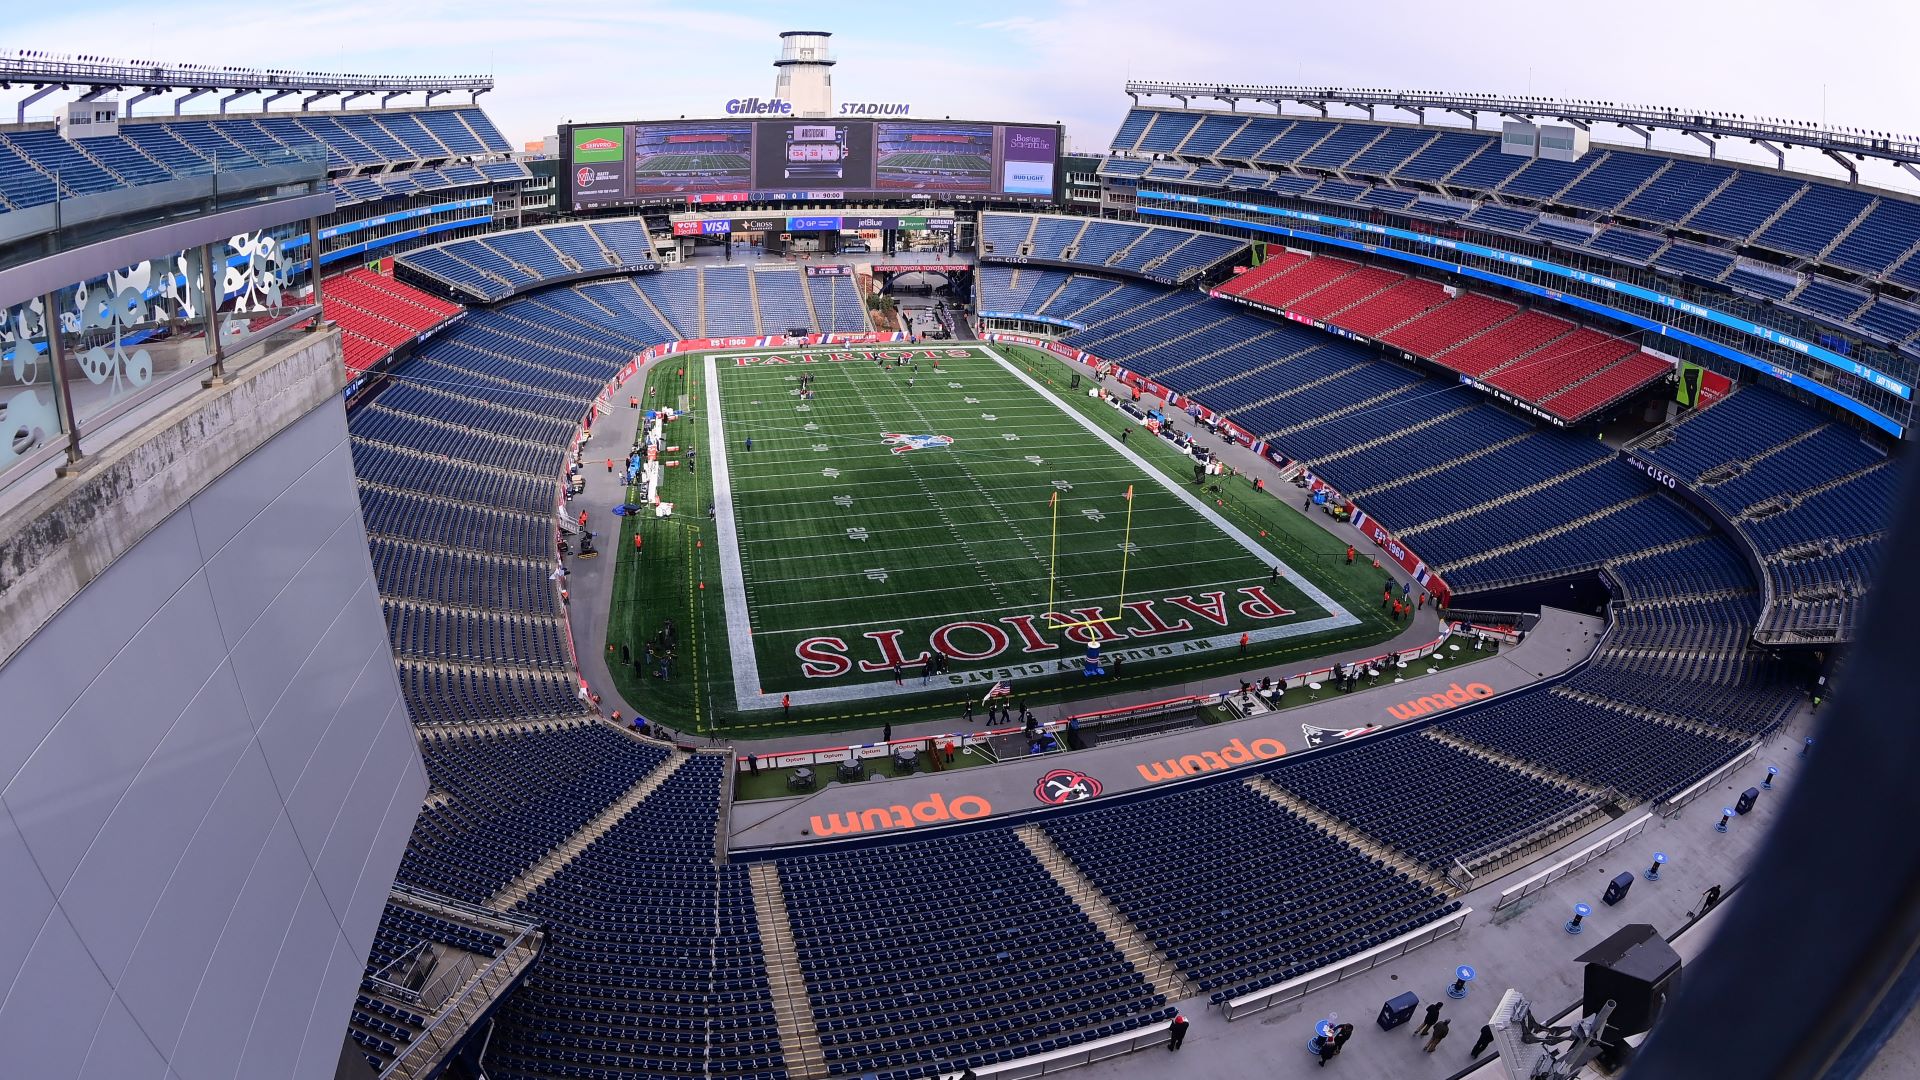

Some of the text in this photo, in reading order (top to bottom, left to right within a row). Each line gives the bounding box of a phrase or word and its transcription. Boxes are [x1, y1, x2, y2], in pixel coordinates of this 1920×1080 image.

[726, 98, 910, 115] Gillette STADIUM
[1010, 138, 1050, 150] Scientific
[1016, 134, 1041, 143] Boston
[703, 221, 730, 232] VISA
[858, 219, 883, 227] jetBlue
[1154, 276, 1172, 285] CISCO
[733, 350, 972, 367] PATRIOTS
[1647, 465, 1676, 489] CISCO
[795, 584, 1296, 679] PATRIOTS
[1182, 639, 1213, 651] MY
[949, 663, 1044, 686] CLEATS
[1386, 681, 1494, 720] Optum
[898, 743, 918, 751] Optum
[1136, 737, 1287, 783] Optum
[809, 792, 993, 838] Optum
